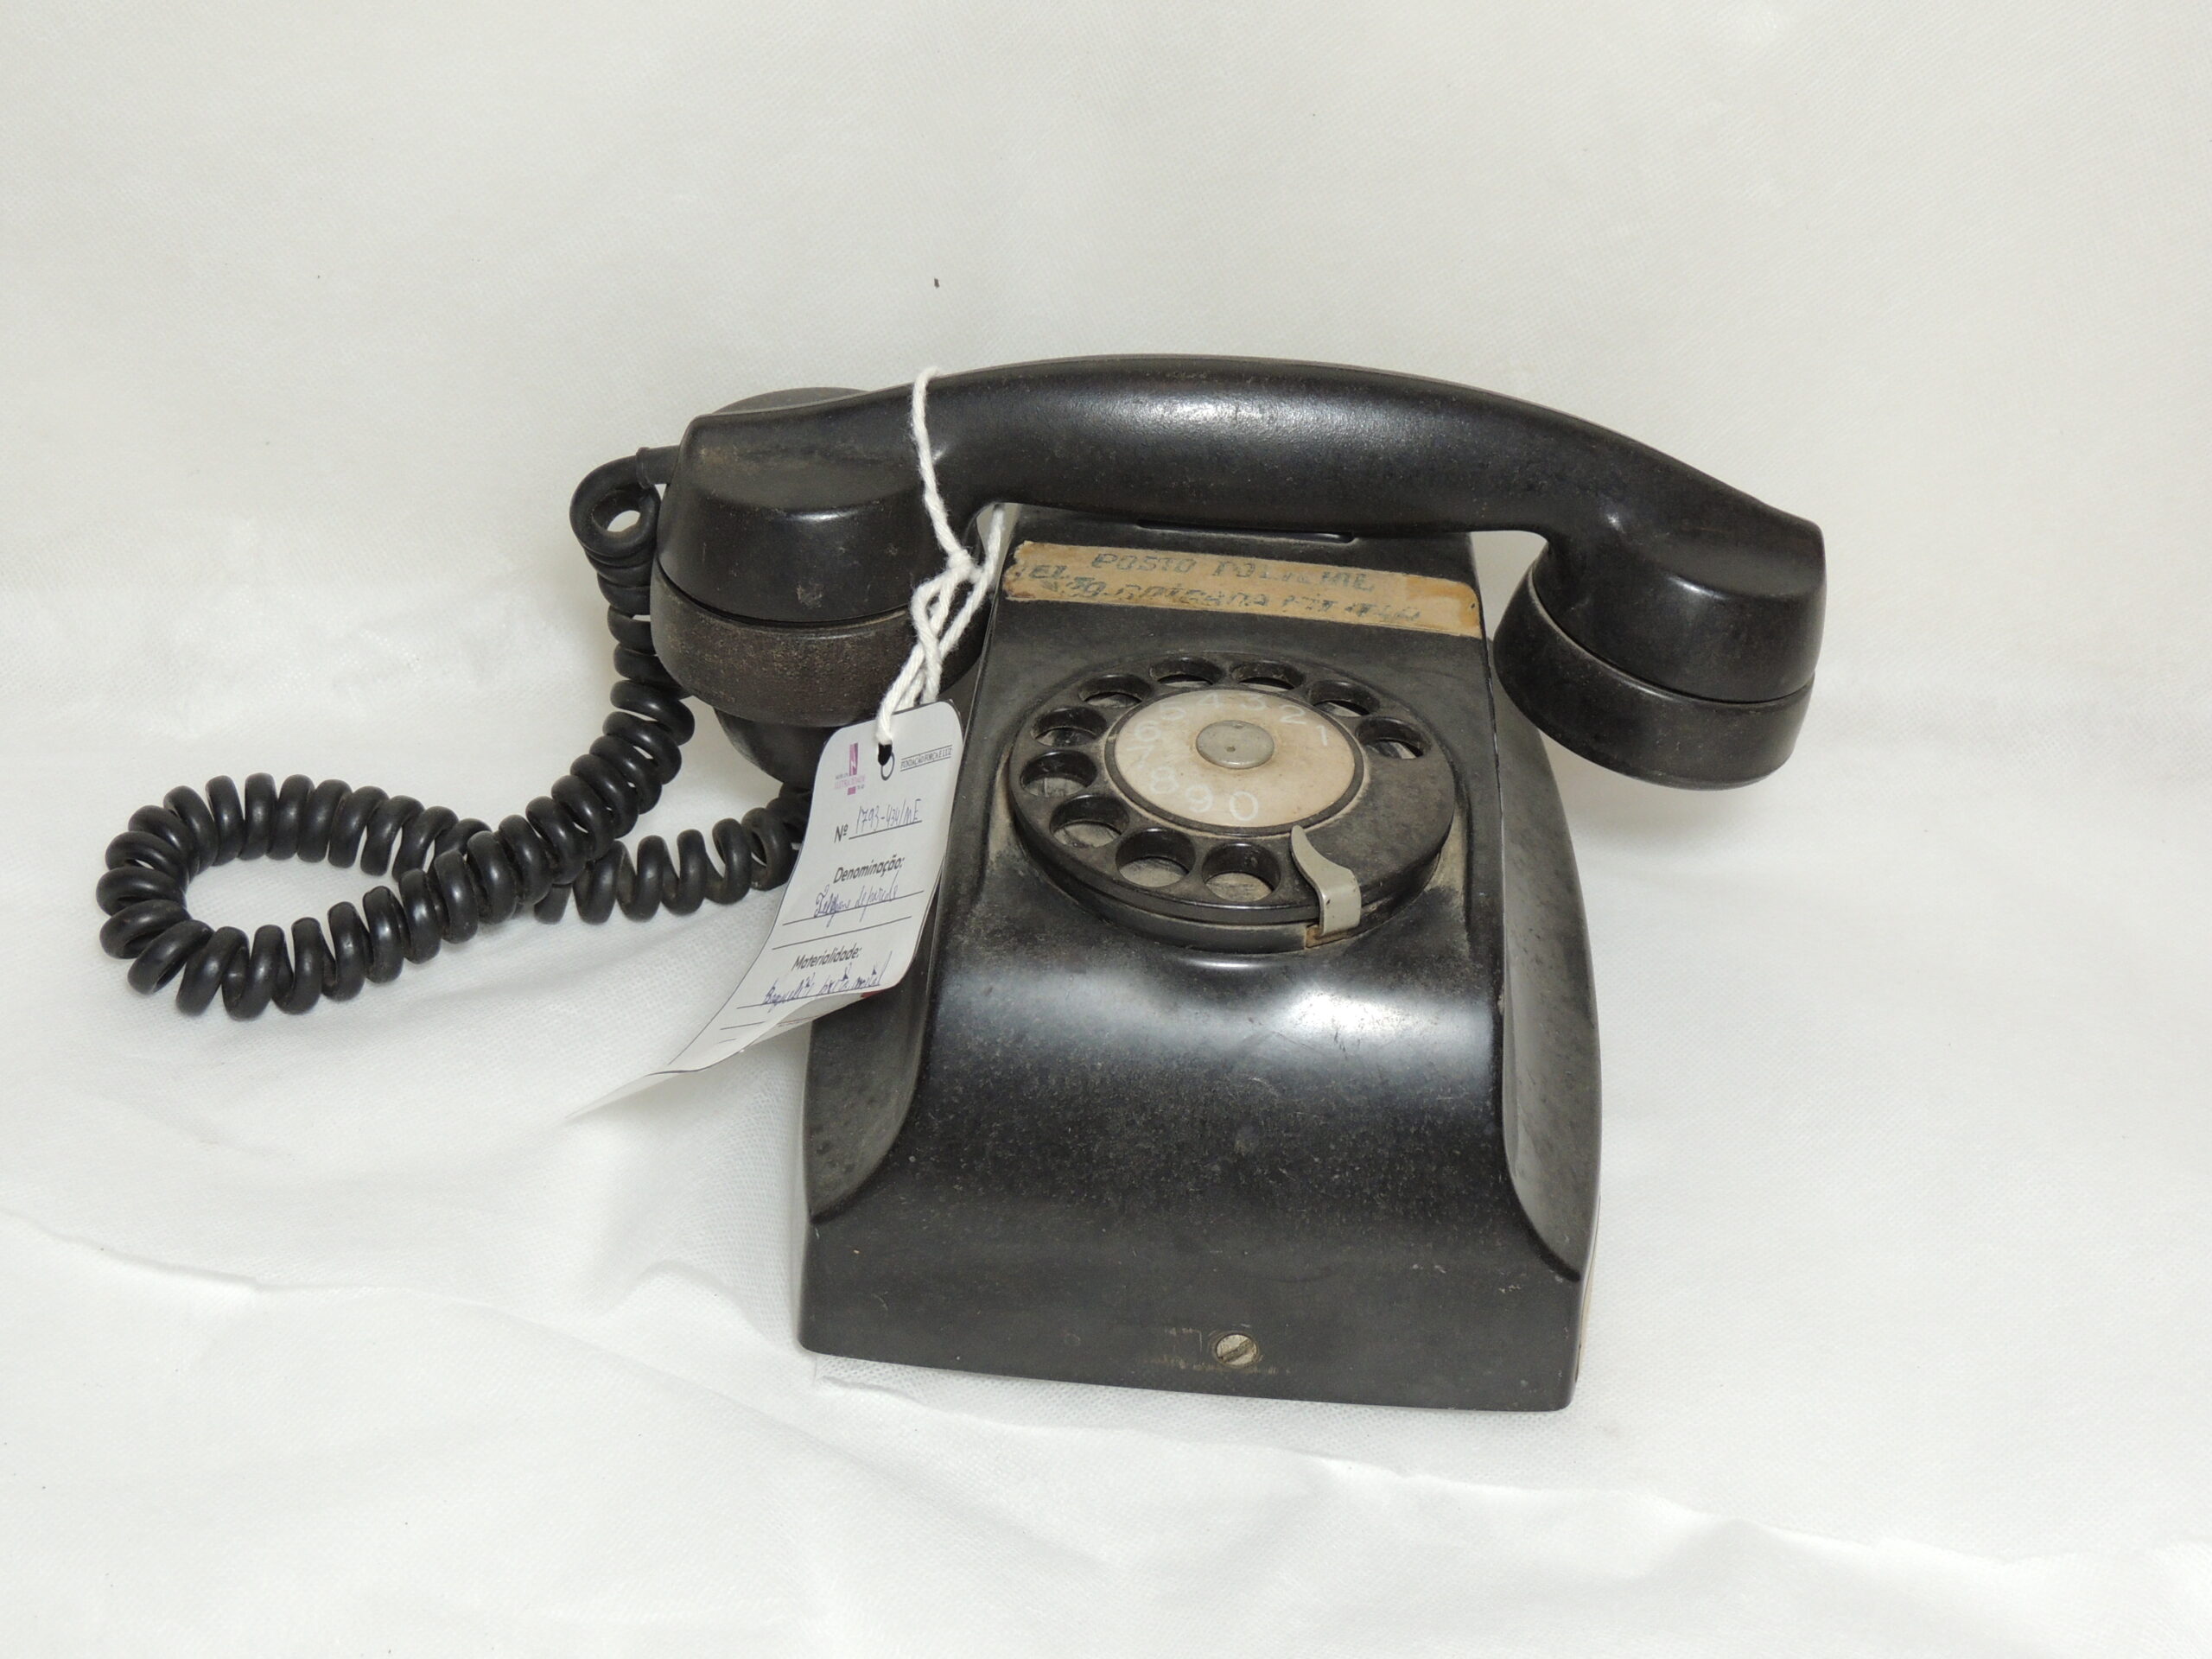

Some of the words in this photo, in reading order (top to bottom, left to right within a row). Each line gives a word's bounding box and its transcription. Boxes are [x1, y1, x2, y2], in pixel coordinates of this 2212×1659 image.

[1090, 553, 1197, 574] POSTO
[1159, 700, 1187, 721] 5
[1196, 690, 1221, 709] 4
[1238, 691, 1268, 711] 3
[1279, 704, 1308, 725] 2
[1133, 720, 1163, 742] 6
[1315, 724, 1329, 747] 1
[1149, 766, 1179, 795] 8
[1185, 784, 1214, 814] 9
[1228, 790, 1260, 822] 0
[833, 854, 906, 884] Denominação:
[791, 943, 862, 972] Materialidade:
